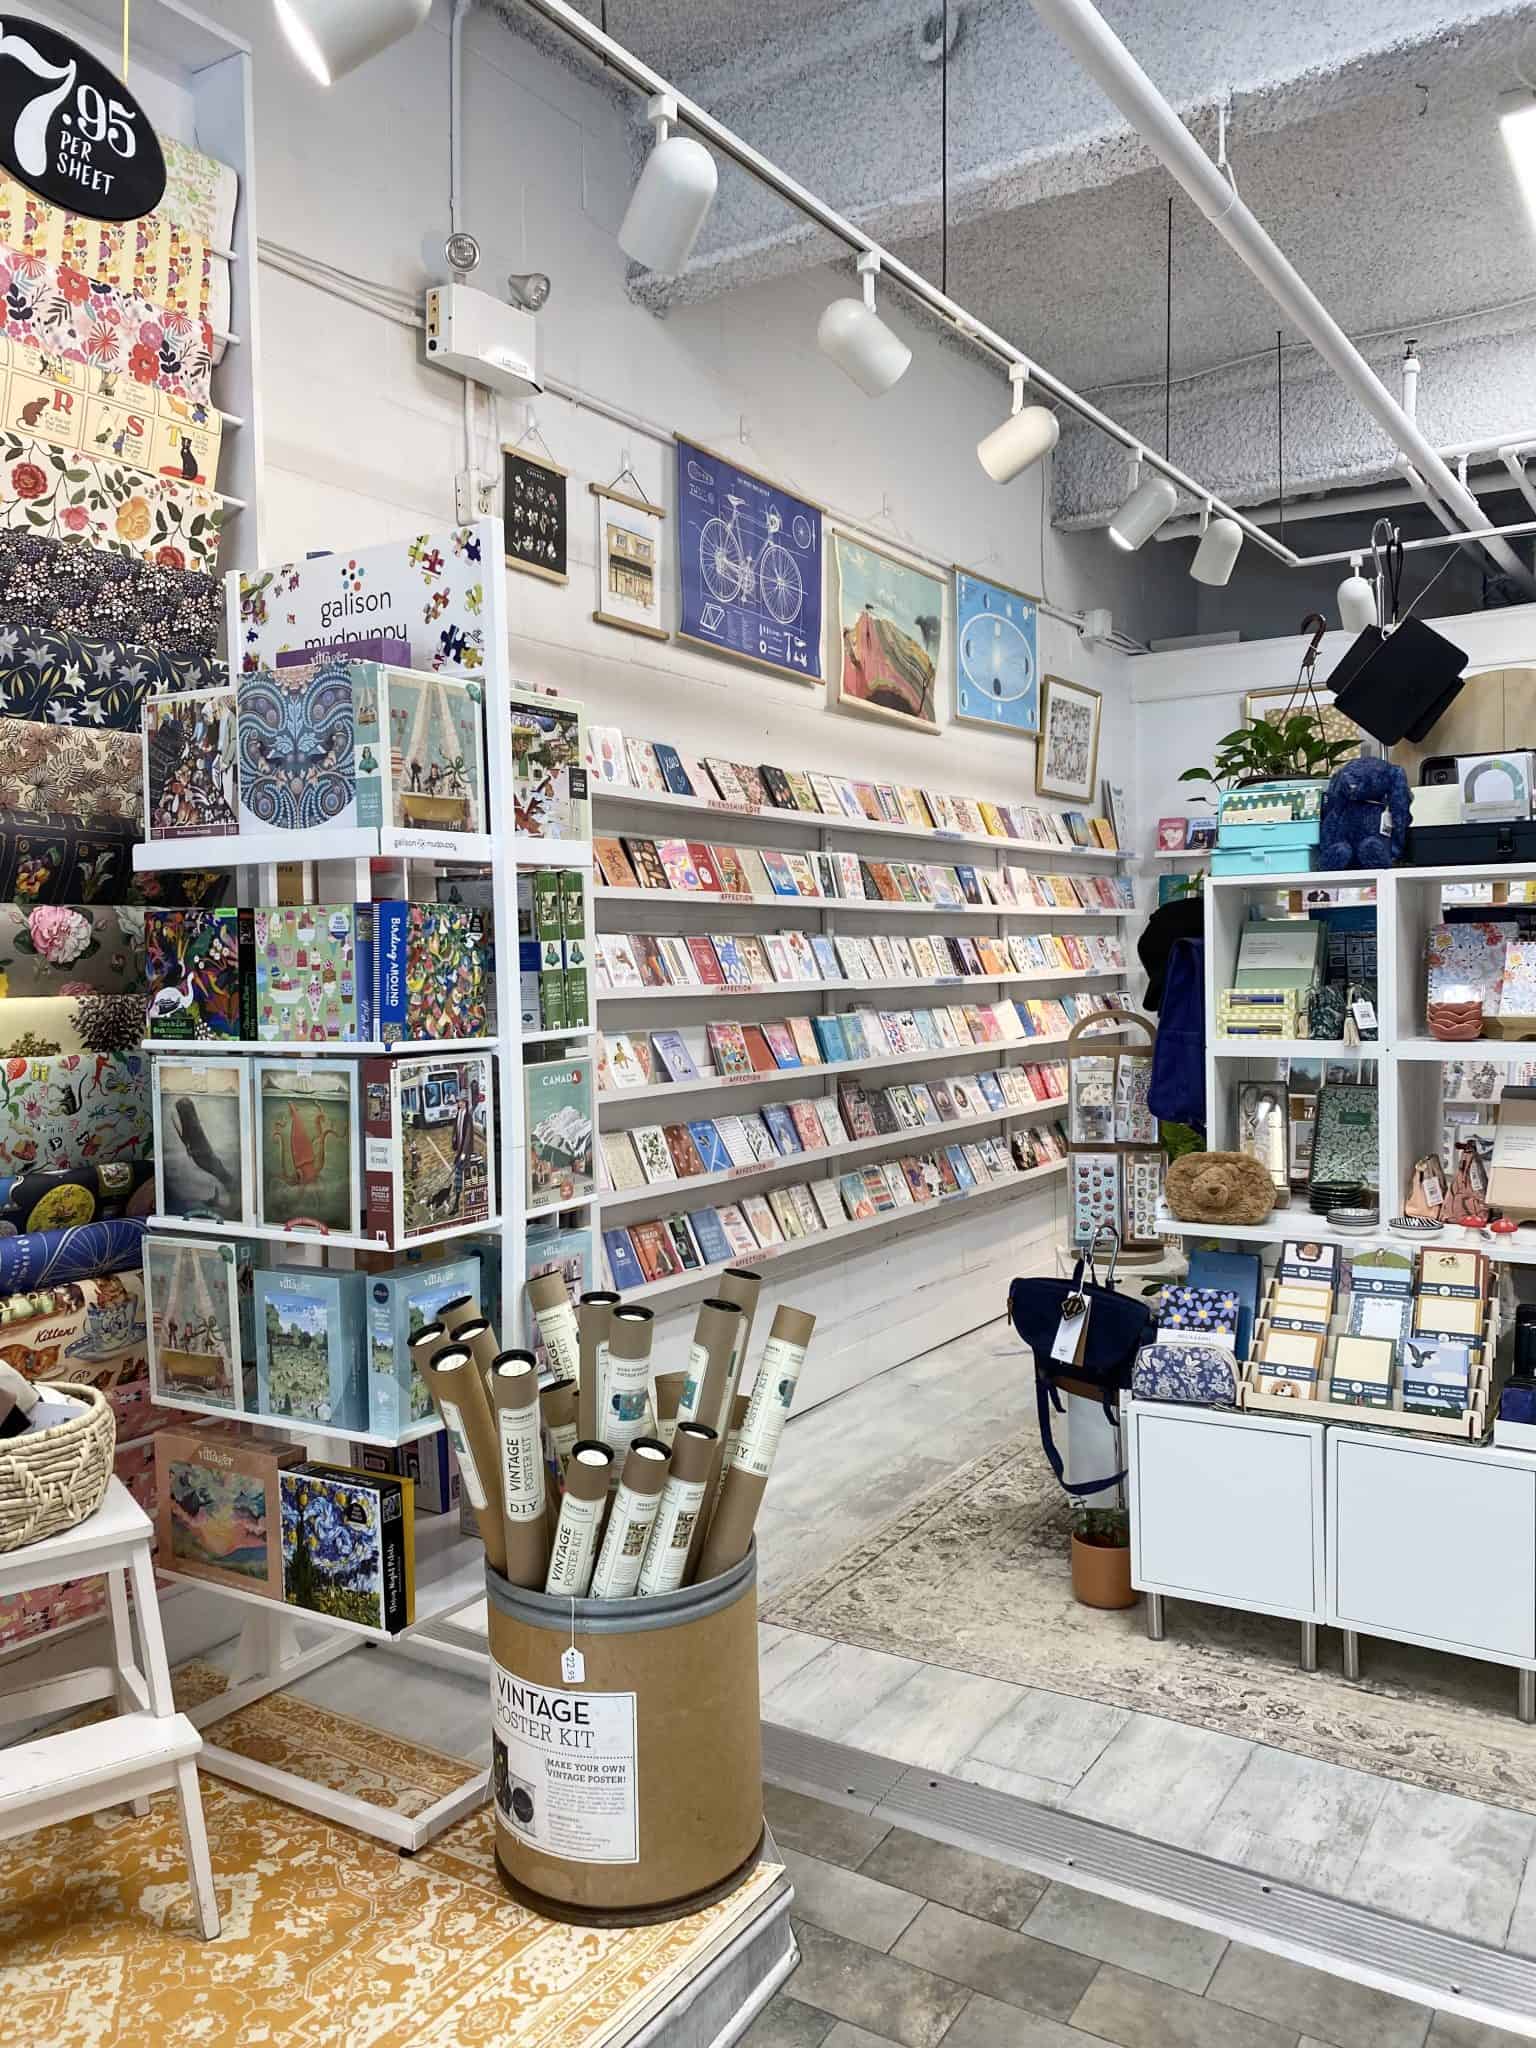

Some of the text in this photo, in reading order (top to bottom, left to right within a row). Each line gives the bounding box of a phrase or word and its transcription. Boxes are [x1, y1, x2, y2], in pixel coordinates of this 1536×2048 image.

[0, 21, 137, 177] 7.95
[59, 130, 92, 163] PER
[56, 153, 115, 196] SHEET
[51, 388, 75, 416] R
[126, 414, 145, 438] S
[320, 591, 392, 628] galison
[390, 962, 400, 1007] AROUND
[720, 984, 753, 993] AFFECTION
[542, 1072, 579, 1087] CANADA
[729, 1075, 761, 1085] AFFECTION
[735, 1163, 767, 1176] AFFECTION
[735, 1253, 768, 1267] AFFECTION
[34, 1326, 77, 1344] Kittens
[506, 1437, 520, 1492] VINTAGE
[521, 1437, 535, 1492] POSTER KIT
[552, 1525, 573, 1582] VINTAGE
[563, 1547, 580, 1587] POSTER
[575, 1528, 585, 1548] KIT
[497, 1671, 591, 1725] VINTAGE
[497, 1698, 595, 1749] POSTER KIT
[546, 1757, 627, 1774] MAKE YOUR OWN
[546, 1768, 627, 1785] VINTAGE POSTER!
